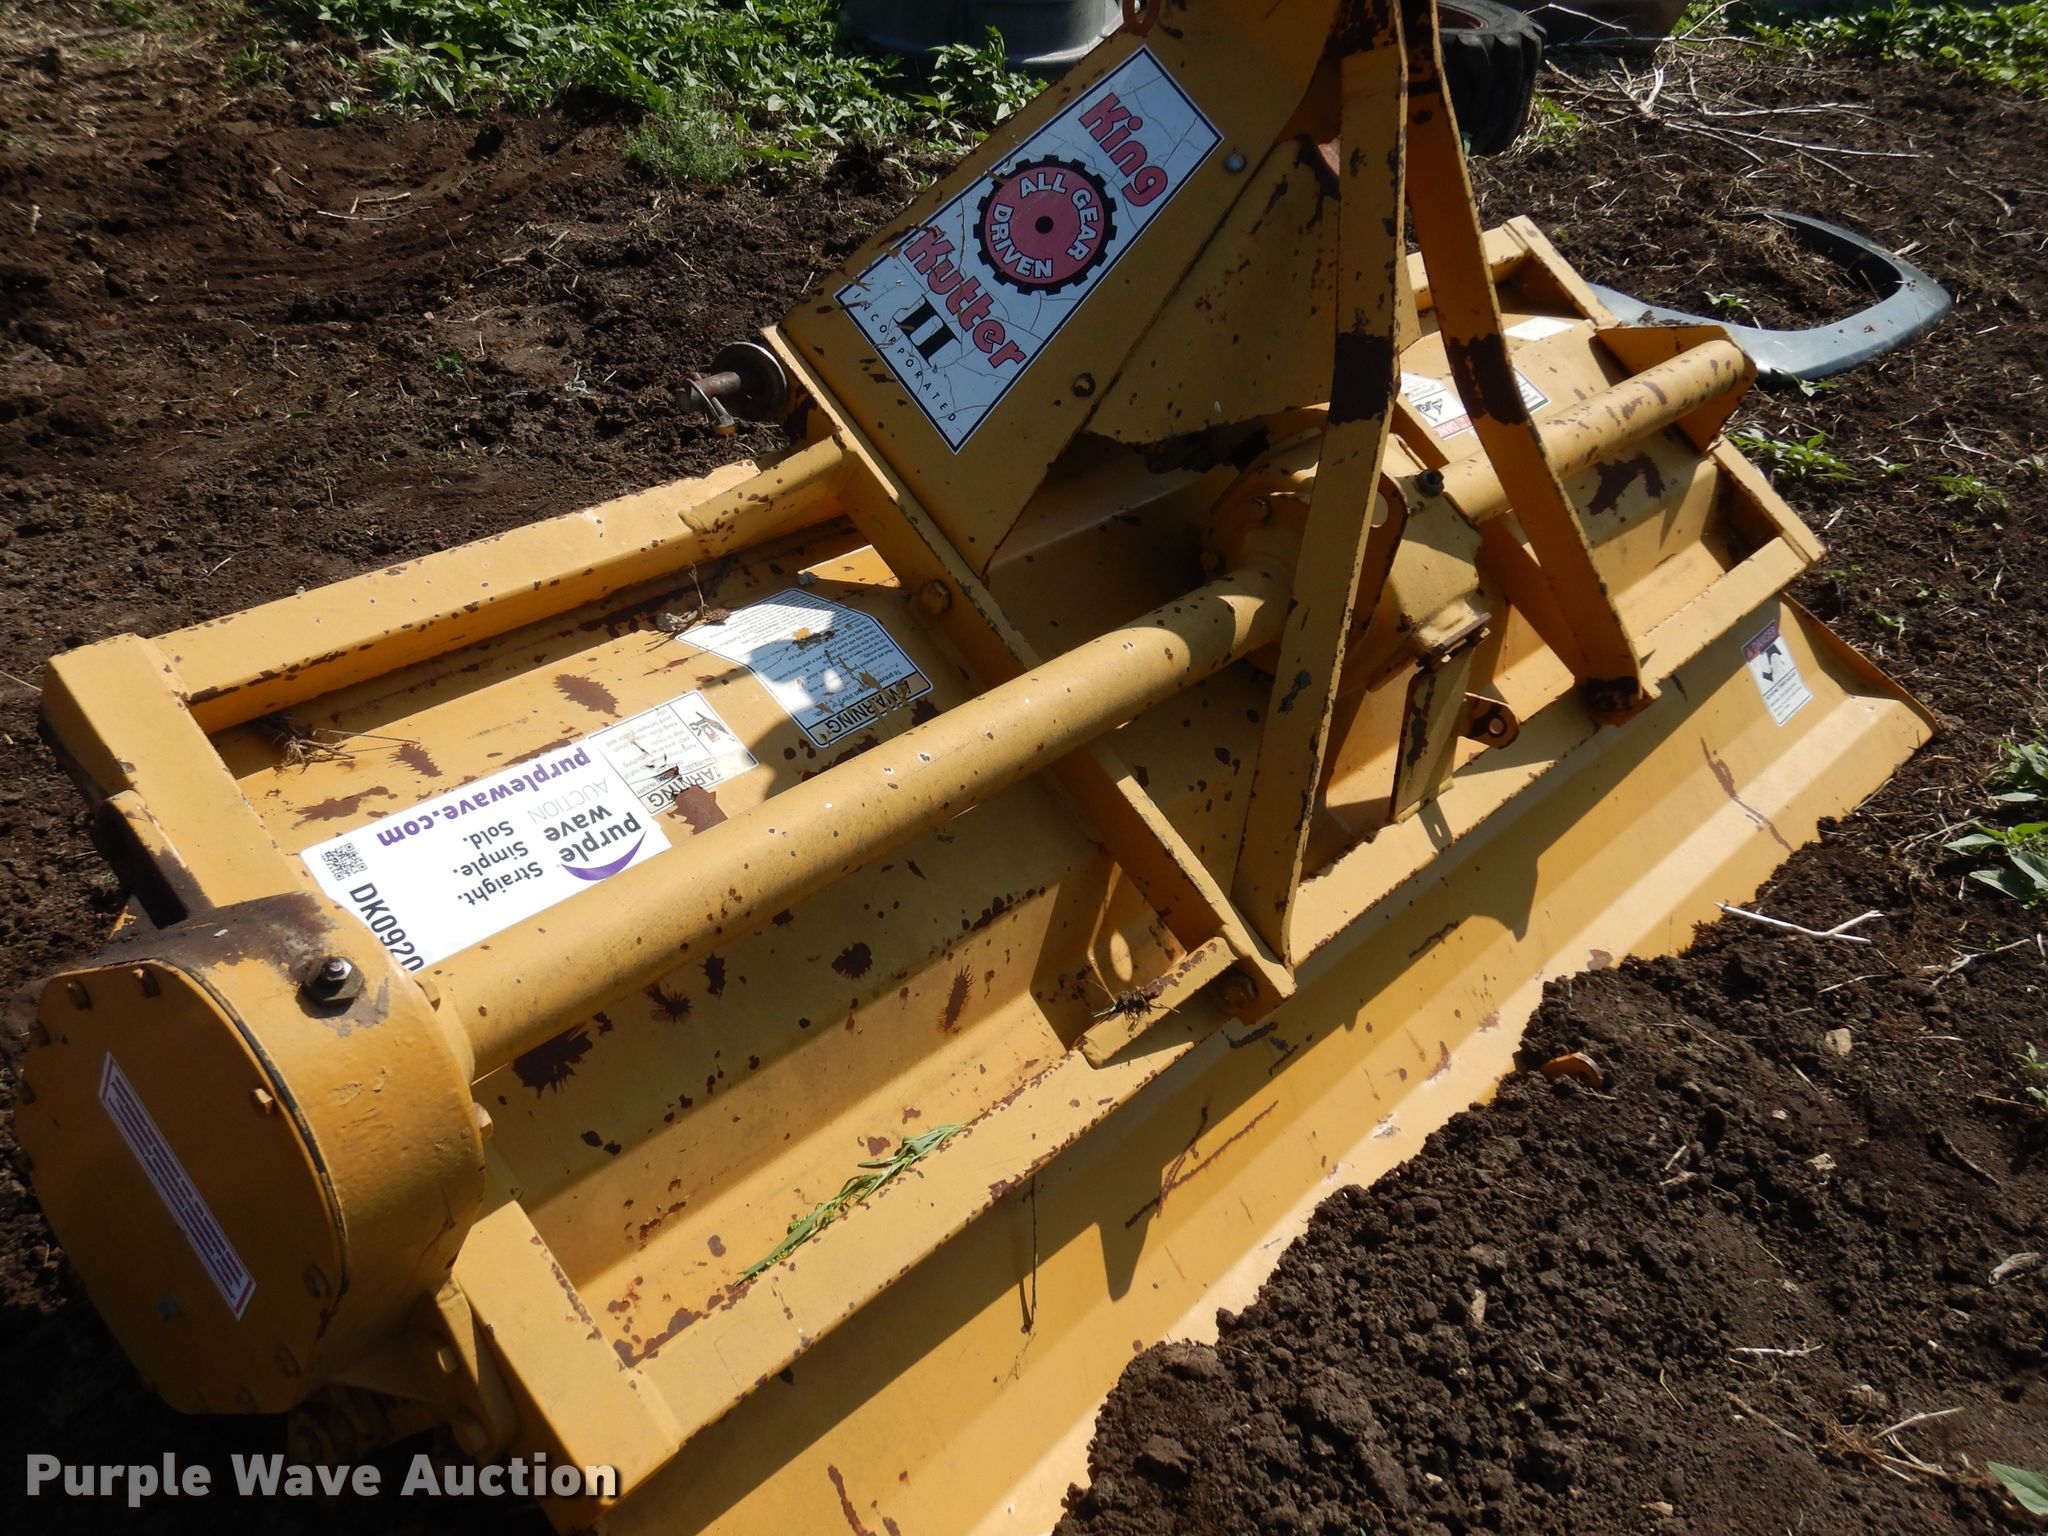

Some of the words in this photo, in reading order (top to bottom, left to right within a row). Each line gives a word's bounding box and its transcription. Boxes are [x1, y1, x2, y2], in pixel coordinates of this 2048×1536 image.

[1078, 92, 1168, 207] King
[1020, 172, 1067, 199] ALL
[1065, 188, 1099, 260] GEAR
[990, 203, 1053, 279] DRIVEN
[903, 225, 1027, 368] Kutter
[853, 292, 957, 422] INCORPORATED
[825, 687, 900, 733] WARNING
[376, 747, 592, 847] purplewave.com
[527, 778, 609, 824] AUCTION
[646, 766, 721, 807] ARNING
[462, 820, 515, 850] Sold.
[543, 805, 613, 842] wave
[558, 812, 642, 862] purple
[453, 841, 529, 876] Simple.
[457, 861, 544, 906] Straight.
